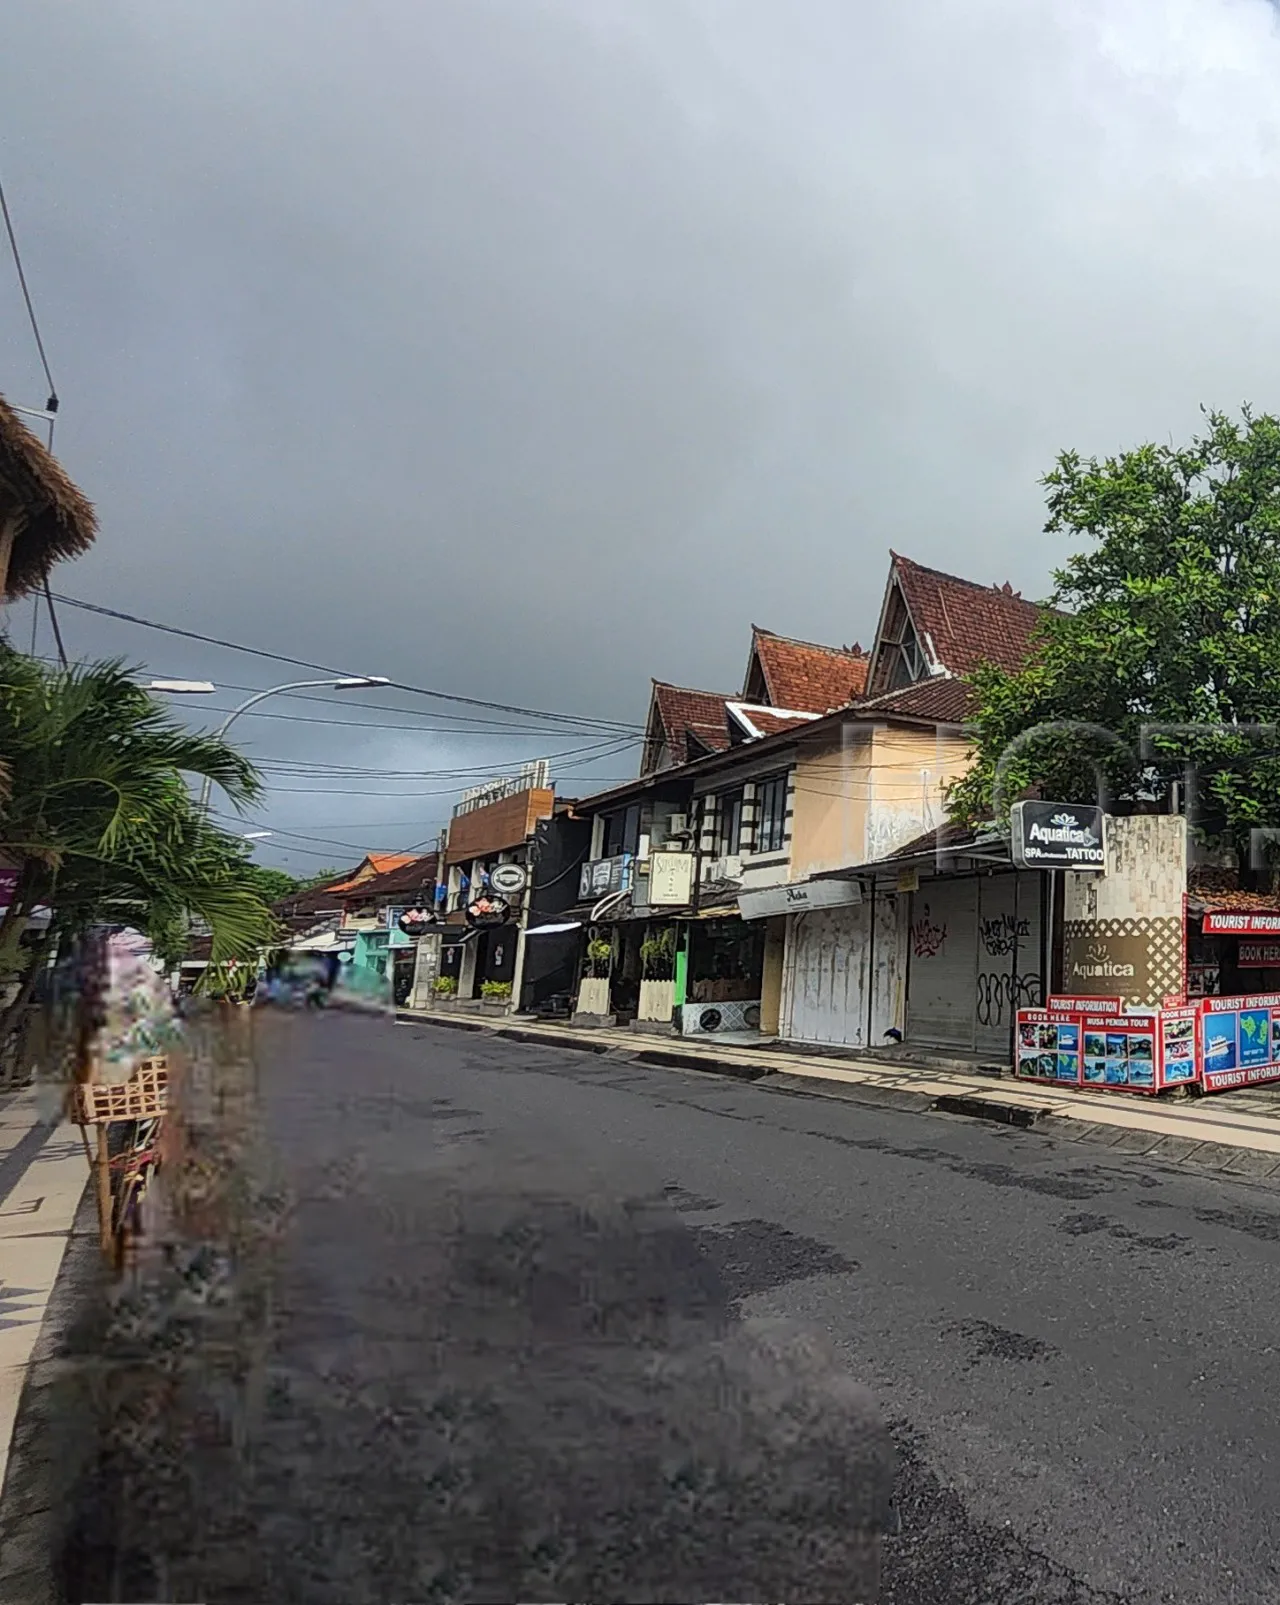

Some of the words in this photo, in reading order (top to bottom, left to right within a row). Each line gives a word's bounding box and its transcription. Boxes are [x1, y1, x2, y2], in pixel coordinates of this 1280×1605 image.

[1029, 822, 1084, 845] Aquatica
[1024, 847, 1041, 858] SPA
[1065, 847, 1104, 860] TATTOO
[1210, 915, 1250, 929] TOURIST
[1239, 946, 1262, 961] BOOK
[1073, 961, 1134, 980] Aquatica
[1050, 999, 1075, 1011] TOURIST
[1075, 1000, 1118, 1014] INFORMATION
[1209, 997, 1245, 1012] TOURIST
[1087, 1017, 1105, 1026] NUSA
[1130, 1018, 1149, 1028] TOUR
[1210, 1071, 1246, 1087] TOURIST
